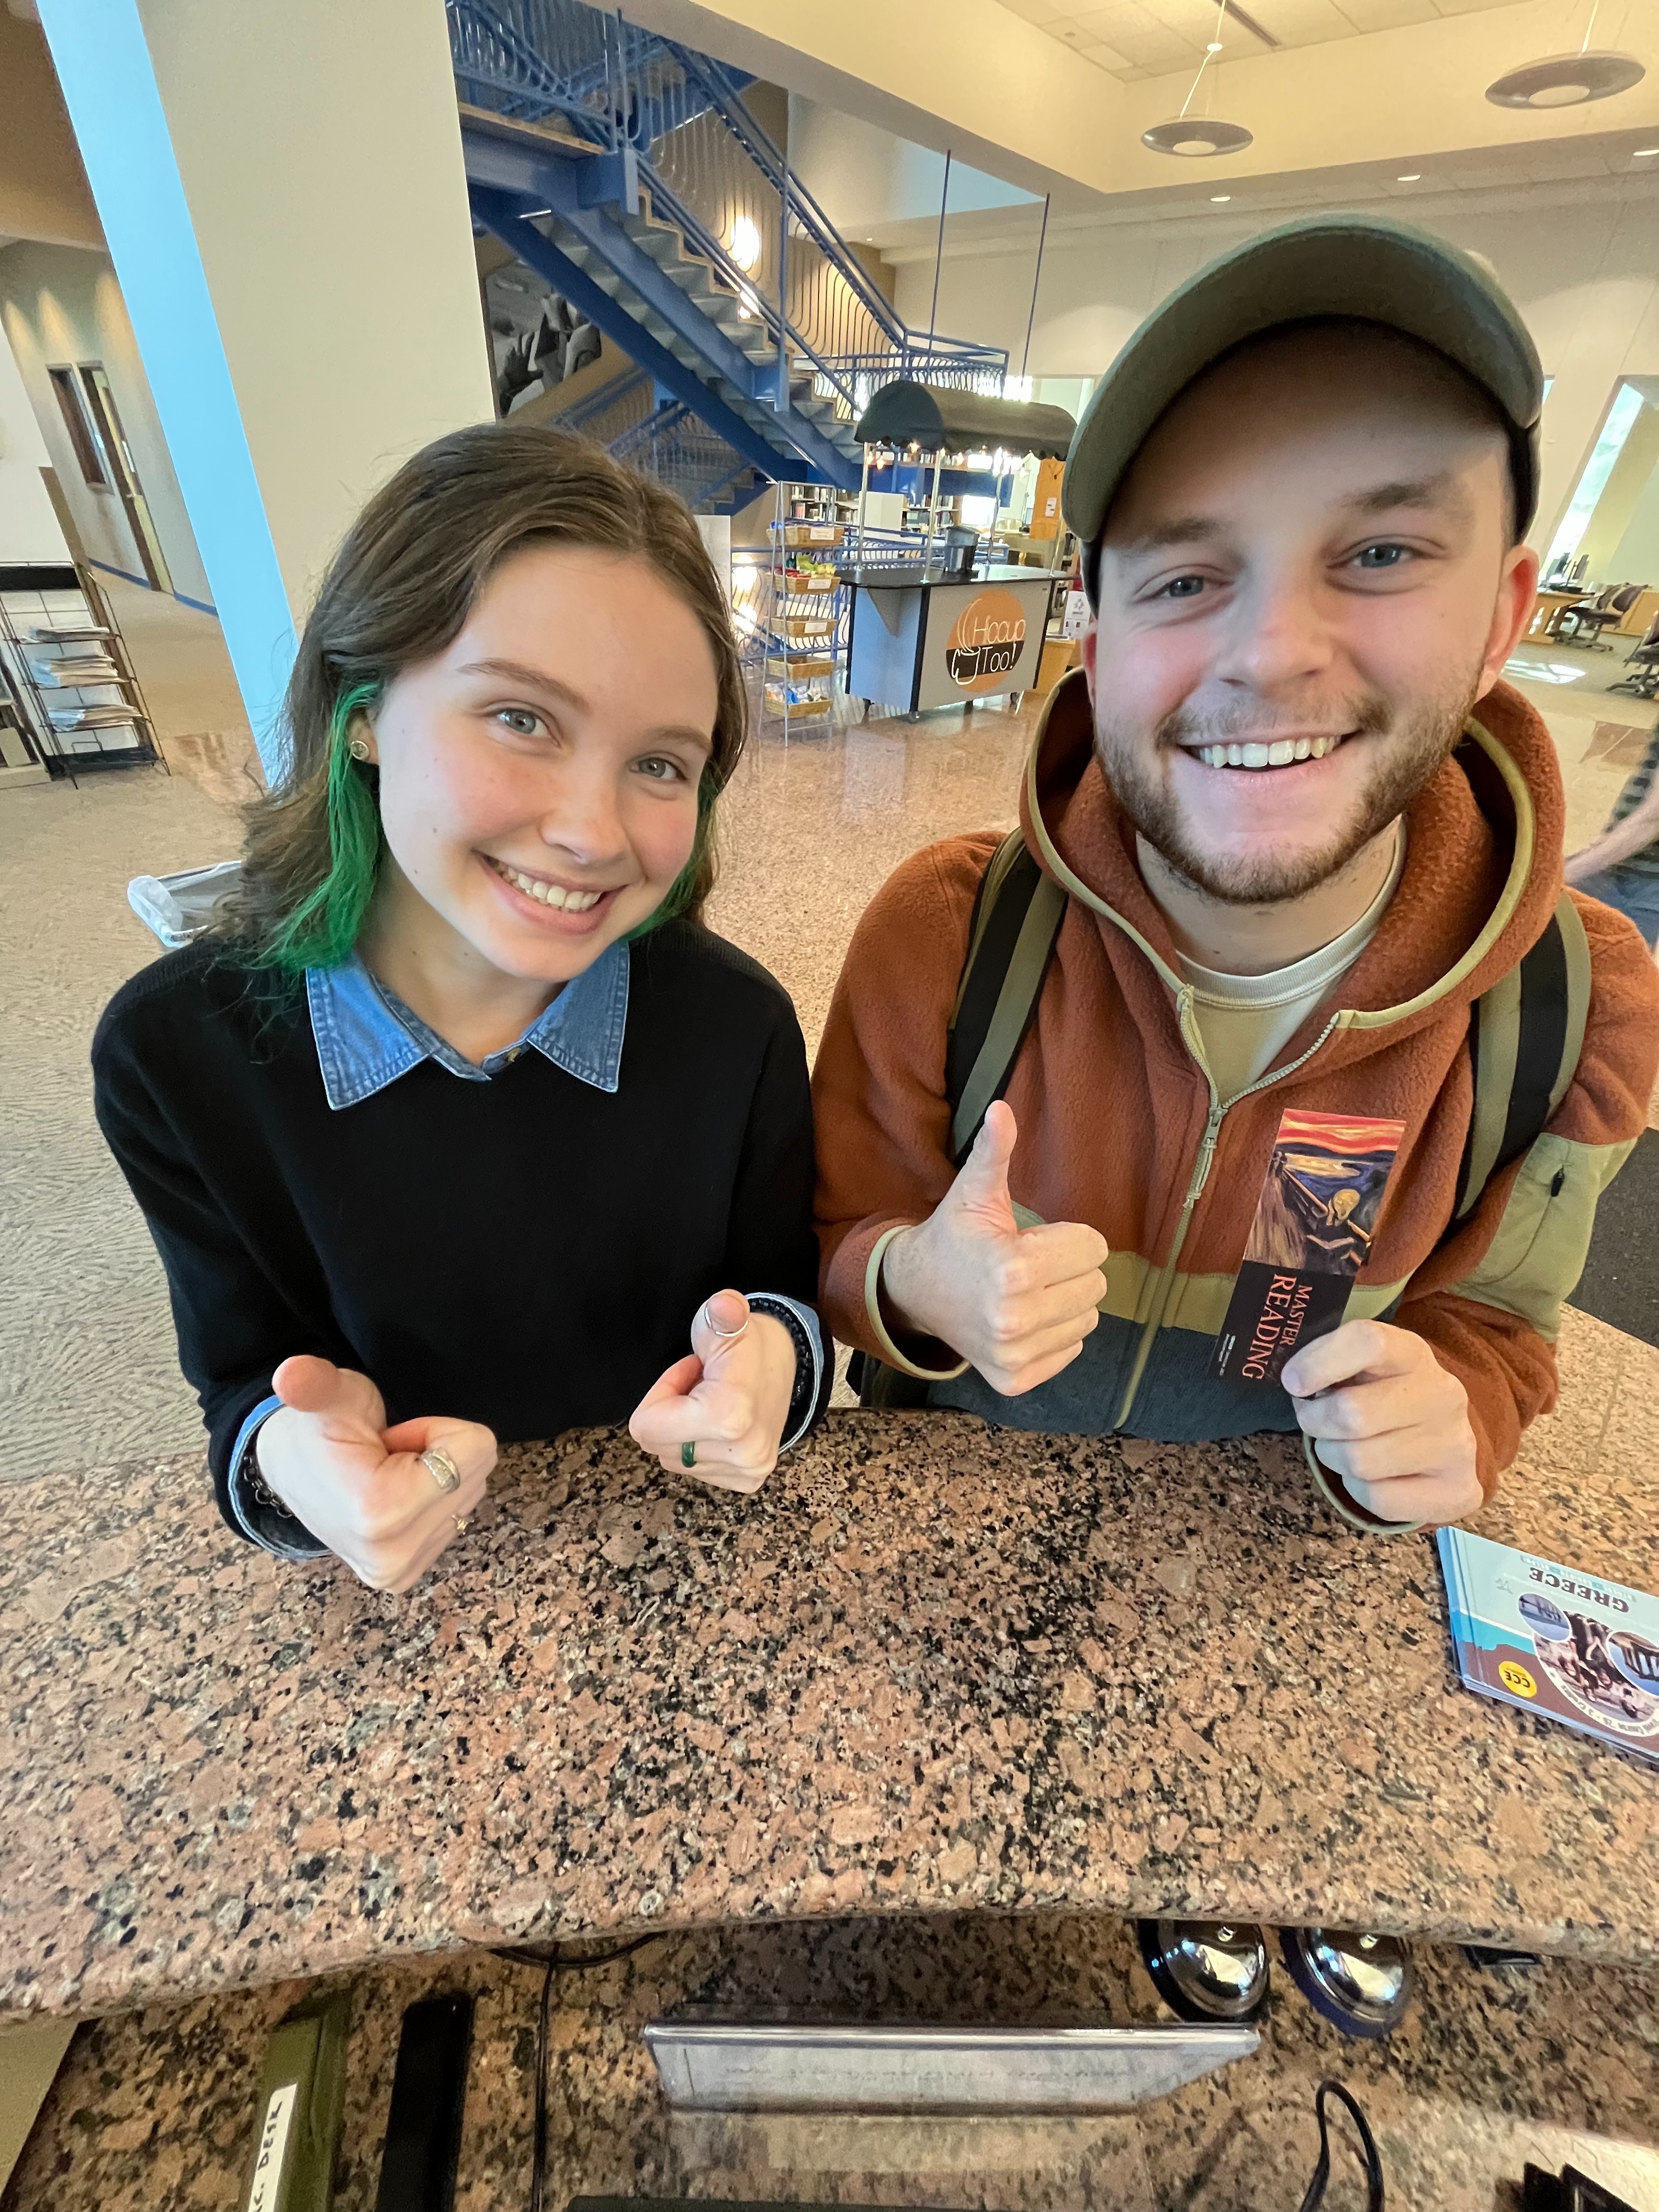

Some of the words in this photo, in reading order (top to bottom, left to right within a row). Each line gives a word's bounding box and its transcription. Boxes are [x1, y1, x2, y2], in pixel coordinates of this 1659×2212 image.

[982, 643, 1017, 674] Too!
[1242, 1273, 1297, 1379] READING
[1279, 1285, 1313, 1345] MASTER
[1529, 1567, 1629, 1613] GREECE
[1504, 1671, 1531, 1689] CCE
[257, 2101, 283, 2171] DESK
